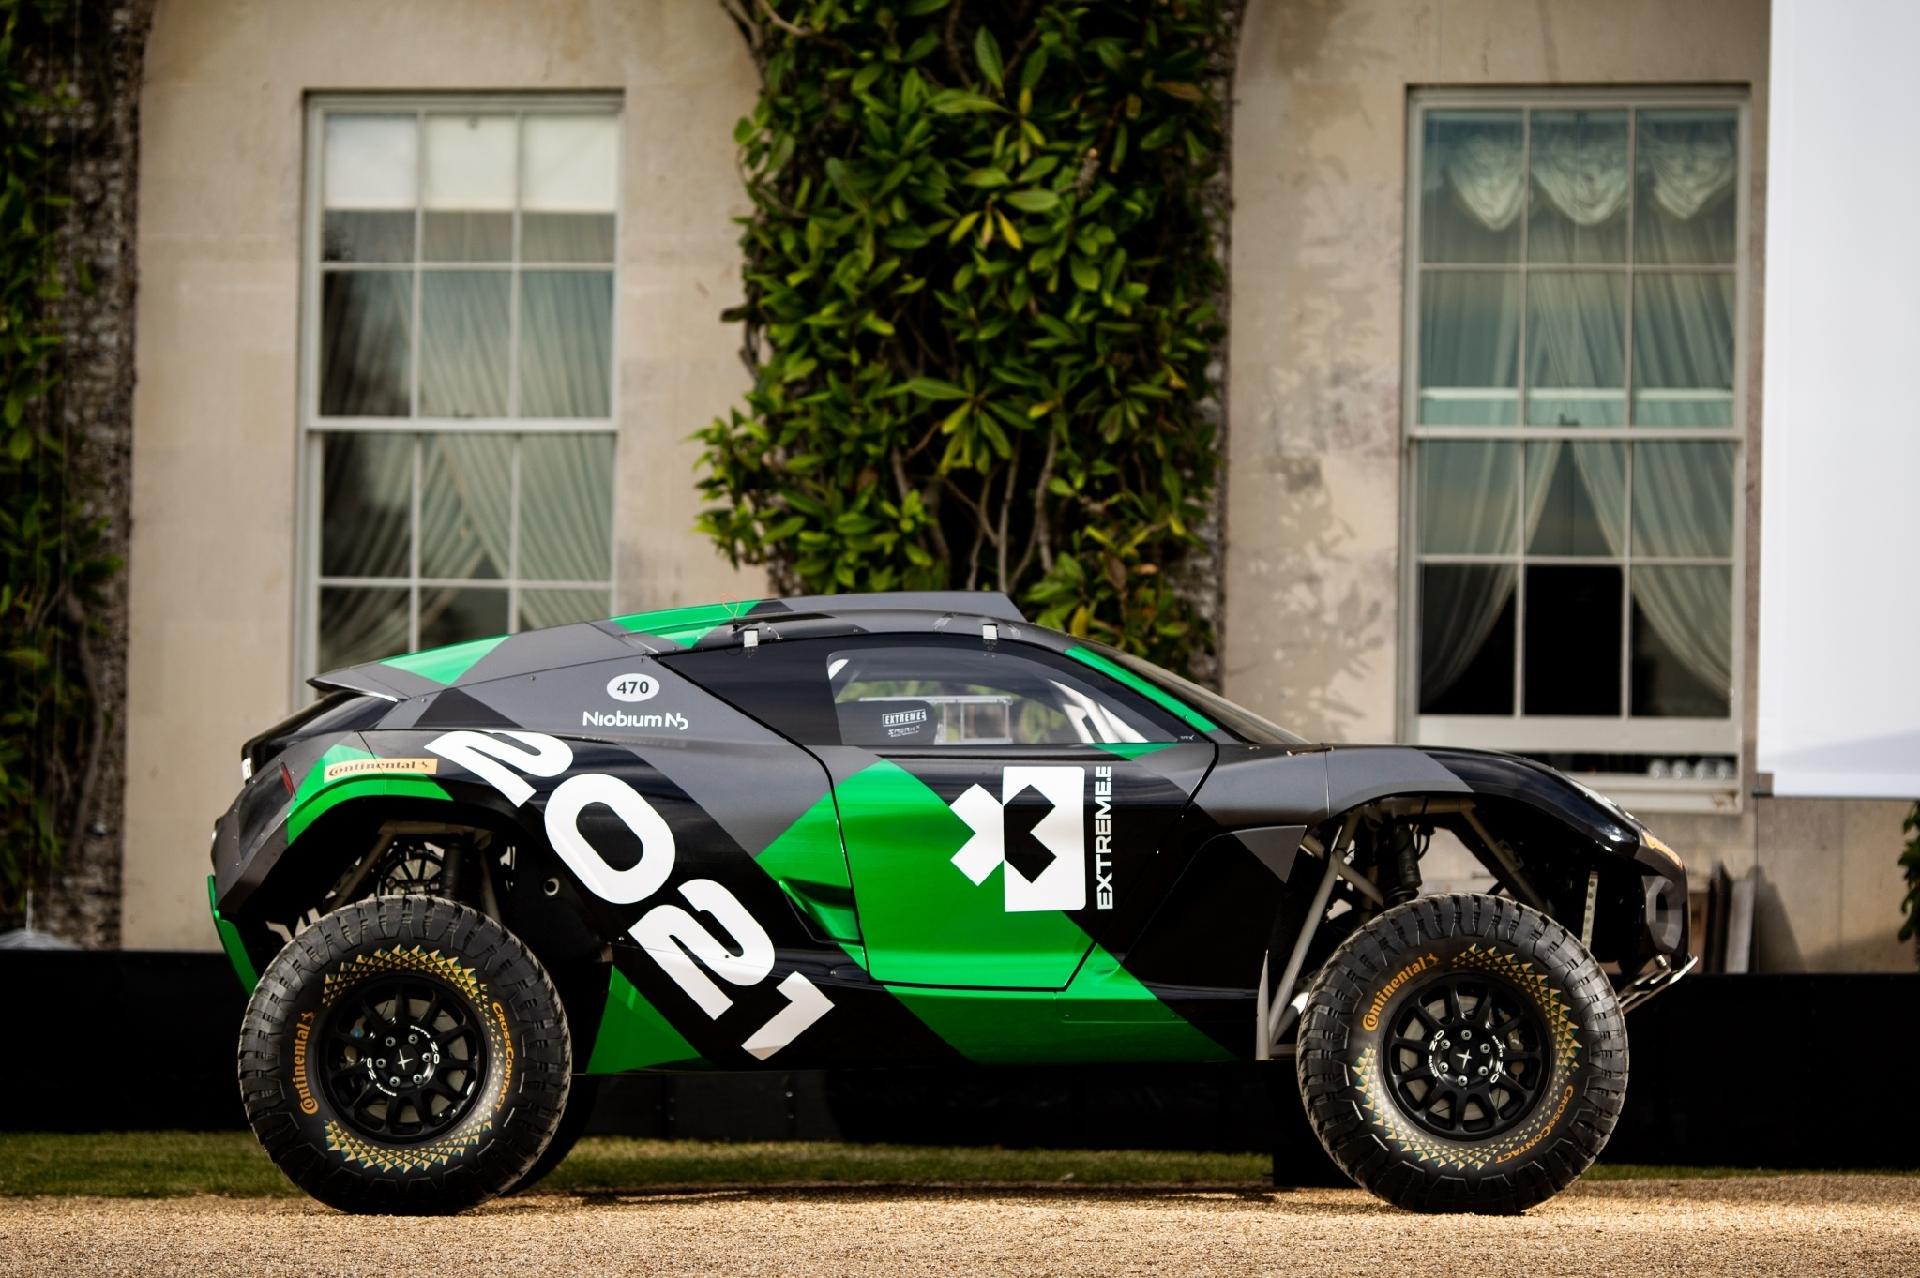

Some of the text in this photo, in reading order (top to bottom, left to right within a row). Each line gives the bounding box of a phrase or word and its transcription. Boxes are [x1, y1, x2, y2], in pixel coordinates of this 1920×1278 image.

[616, 681, 650, 695] 470
[582, 710, 662, 727] Niobium
[328, 761, 416, 777] Continental
[424, 729, 836, 1061] 2021
[1362, 957, 1426, 1032] Continental
[292, 1022, 320, 1116] Continental
